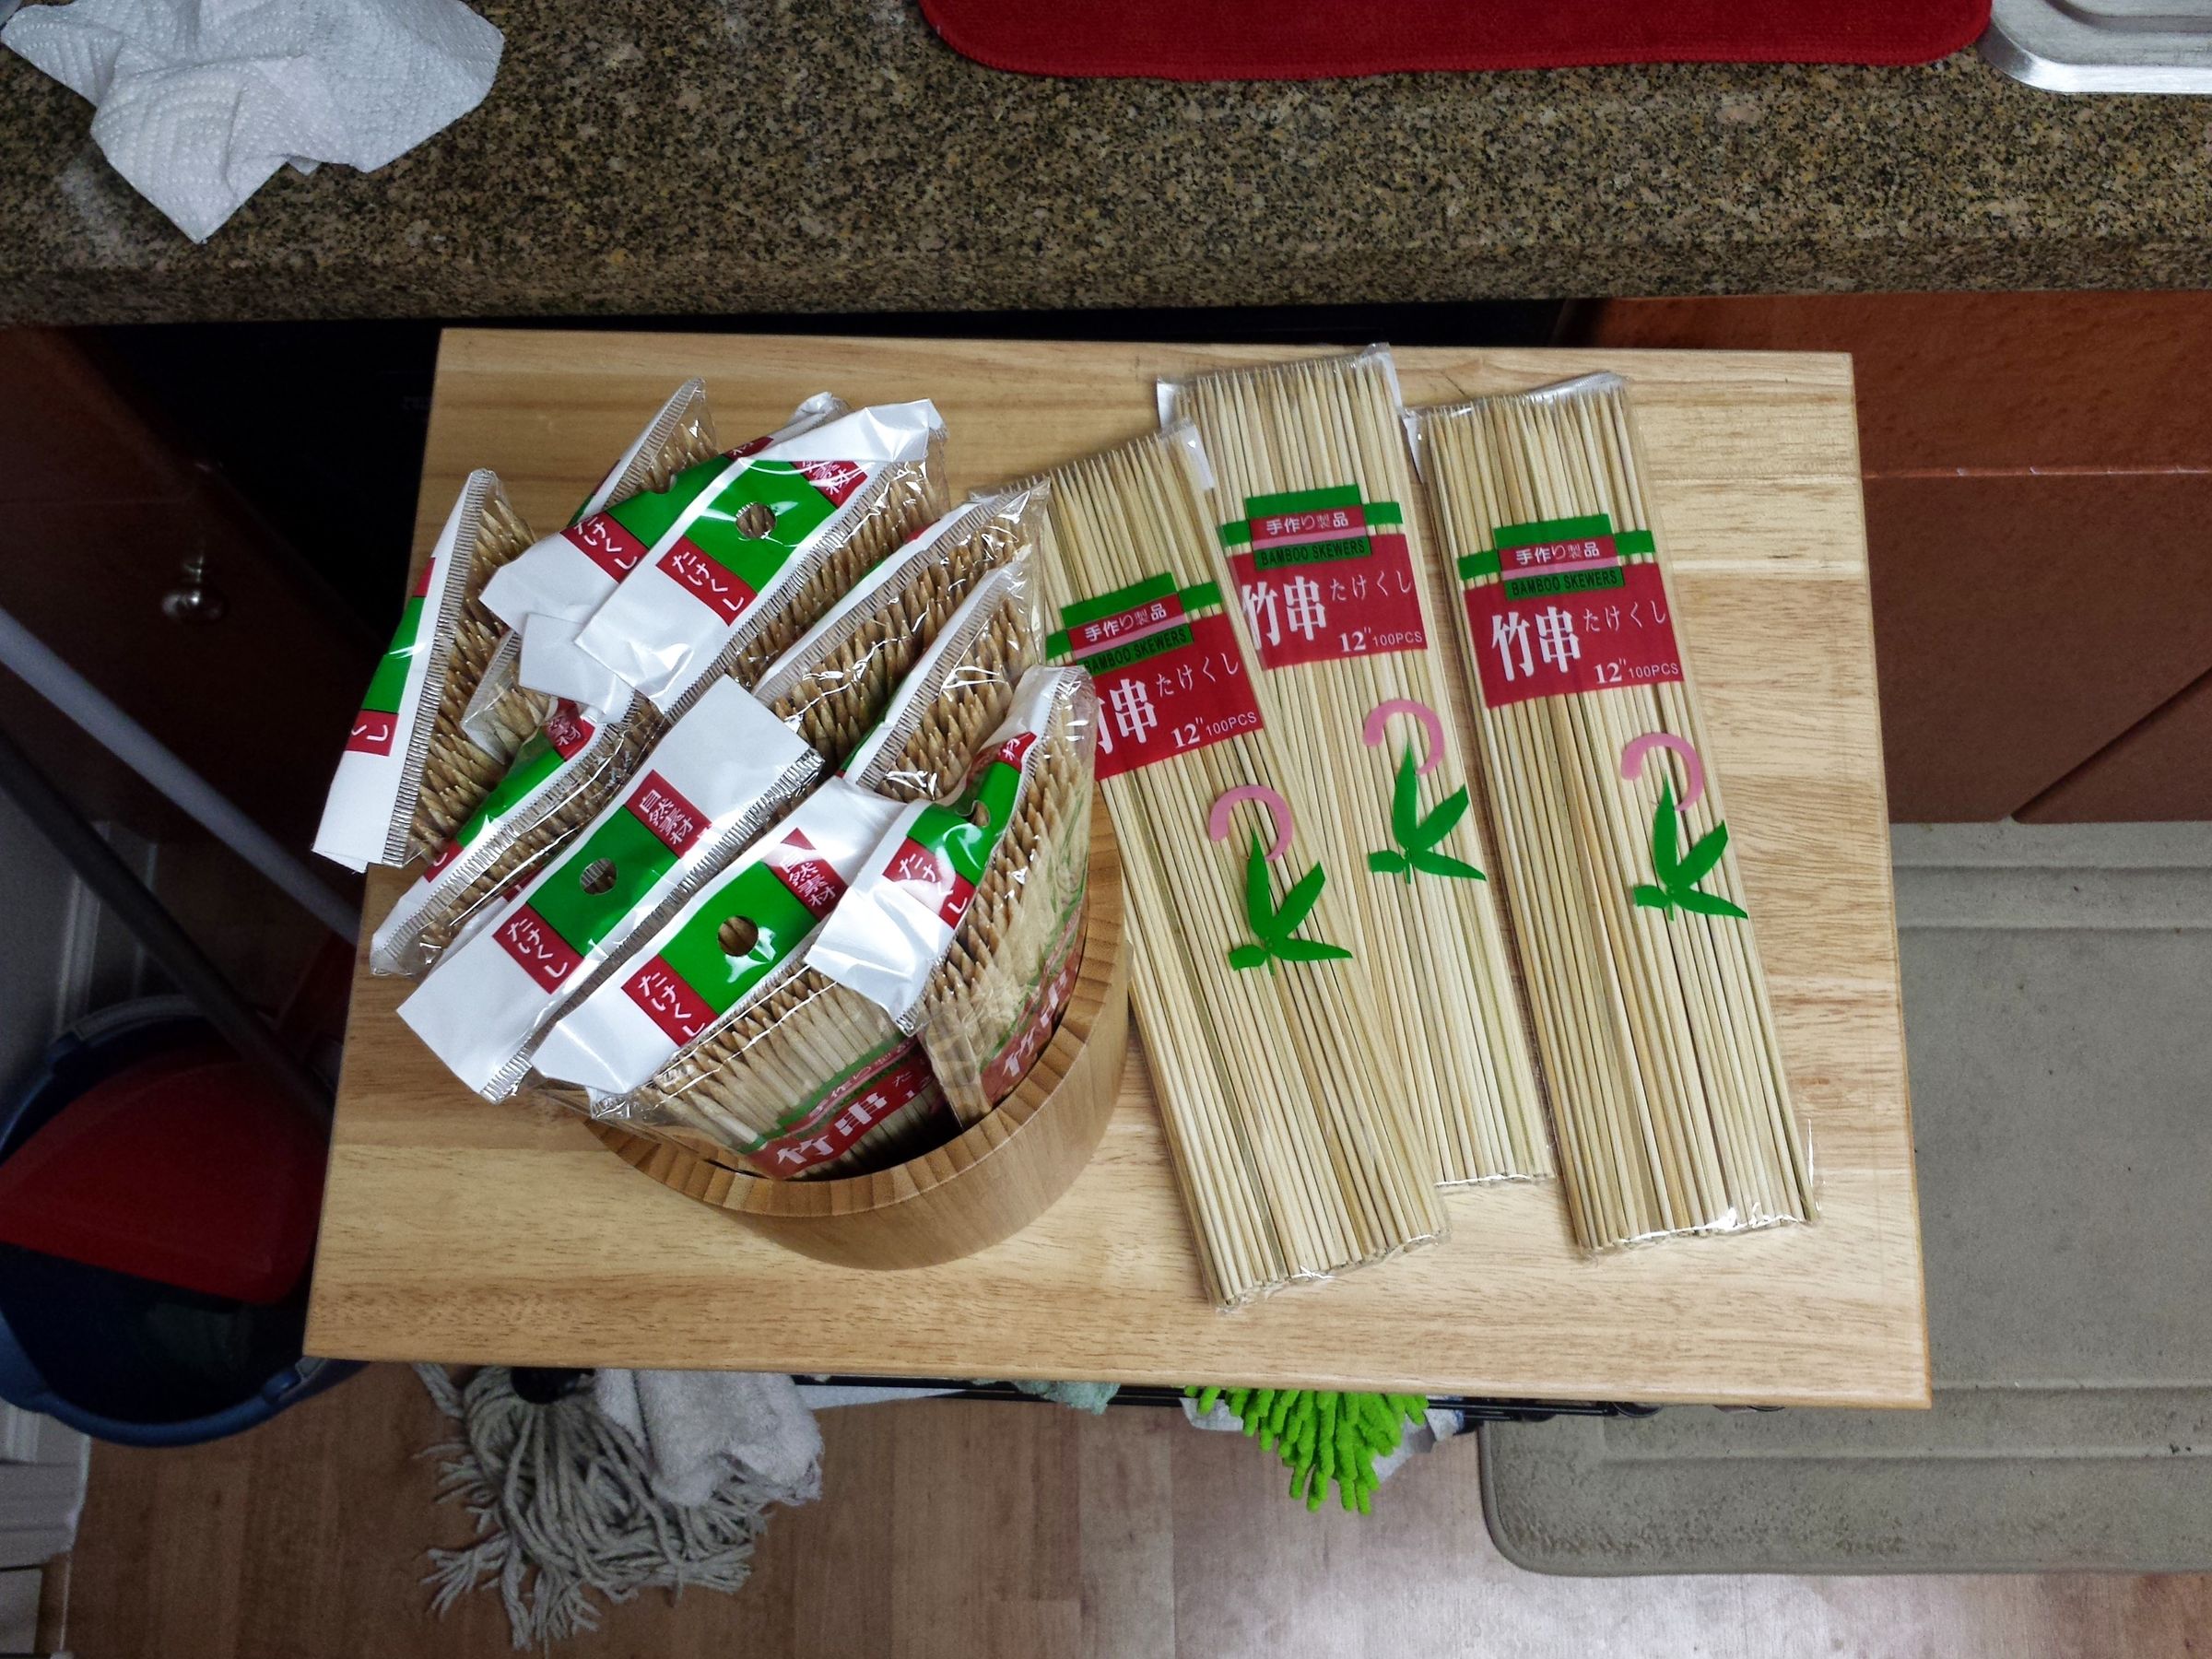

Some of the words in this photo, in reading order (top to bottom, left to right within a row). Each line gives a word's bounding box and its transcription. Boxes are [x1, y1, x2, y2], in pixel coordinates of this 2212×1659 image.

[573, 516, 638, 571] たけくし
[1265, 512, 1349, 535] 手作り製品
[1260, 546, 1310, 566] BAMBOO
[1312, 538, 1365, 559] SKEWERS
[1515, 541, 1601, 565] 手作り製品
[672, 550, 745, 612] たけくし
[1511, 576, 1561, 596] BAMBOO
[1563, 571, 1618, 590] SKEWERS
[1084, 603, 1168, 642] 手作り製品
[1241, 575, 1327, 651] 竹串
[1329, 570, 1412, 602] たけくし
[1083, 649, 1132, 675] BAMBOO
[1134, 628, 1188, 658] SKEWERS
[1371, 630, 1423, 647] 100PCS
[1491, 606, 1583, 682] 竹串
[1583, 600, 1666, 632] たけくし
[1156, 653, 1240, 698] たけくし
[1628, 663, 1679, 679] 100PCS
[1206, 712, 1257, 736] 100PCS
[639, 789, 694, 845] 自然素材
[779, 850, 837, 907] 自然素材
[506, 918, 569, 979] たけくし
[636, 971, 707, 1038] たけくし
[776, 1092, 888, 1165] 竹串
